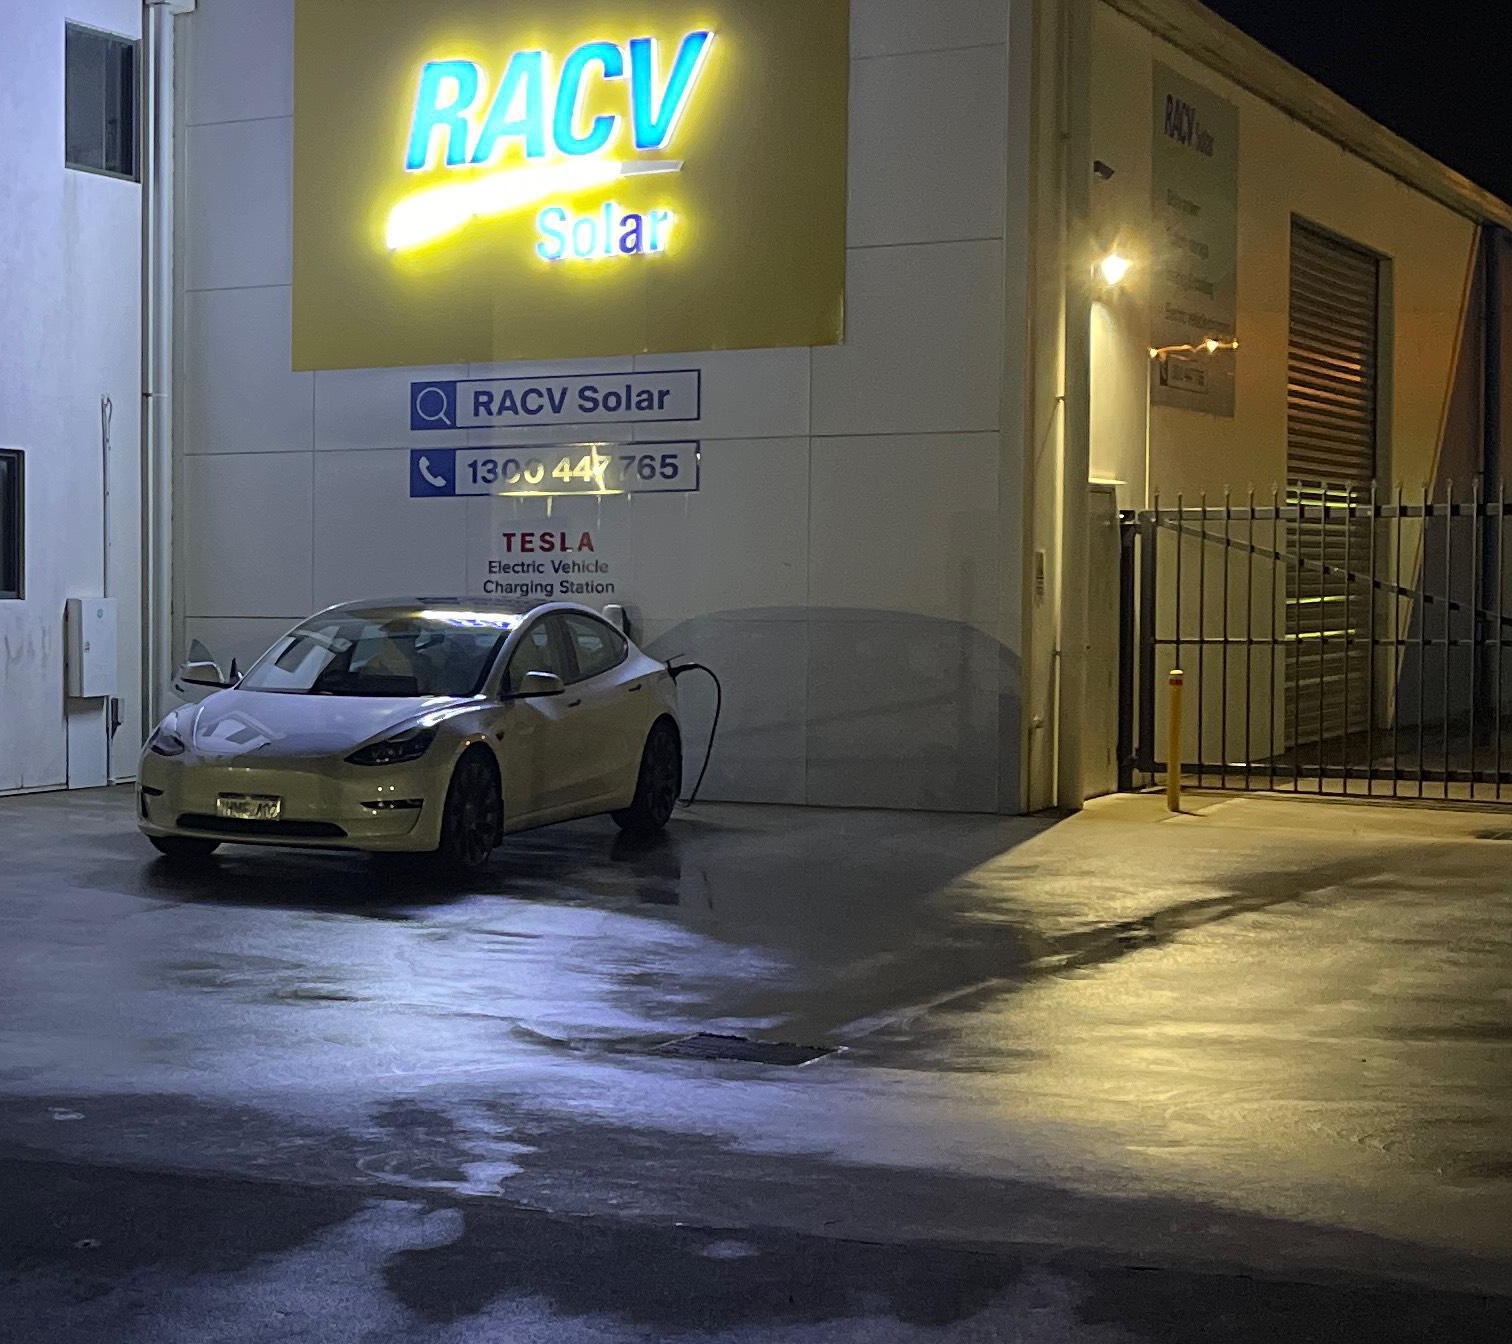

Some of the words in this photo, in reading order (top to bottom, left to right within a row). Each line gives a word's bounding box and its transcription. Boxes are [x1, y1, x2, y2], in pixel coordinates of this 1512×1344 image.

[404, 30, 716, 172] RACV
[534, 201, 675, 262] Solar
[472, 387, 568, 418] RACV
[577, 384, 671, 414] Solar
[468, 458, 546, 485] 1300
[552, 455, 612, 484] 447
[619, 453, 679, 482] 765
[502, 531, 595, 553] TESLA
[488, 559, 545, 575] Electric
[551, 559, 609, 574] Vehicle
[483, 579, 554, 597] Charging
[559, 578, 615, 595] Station
